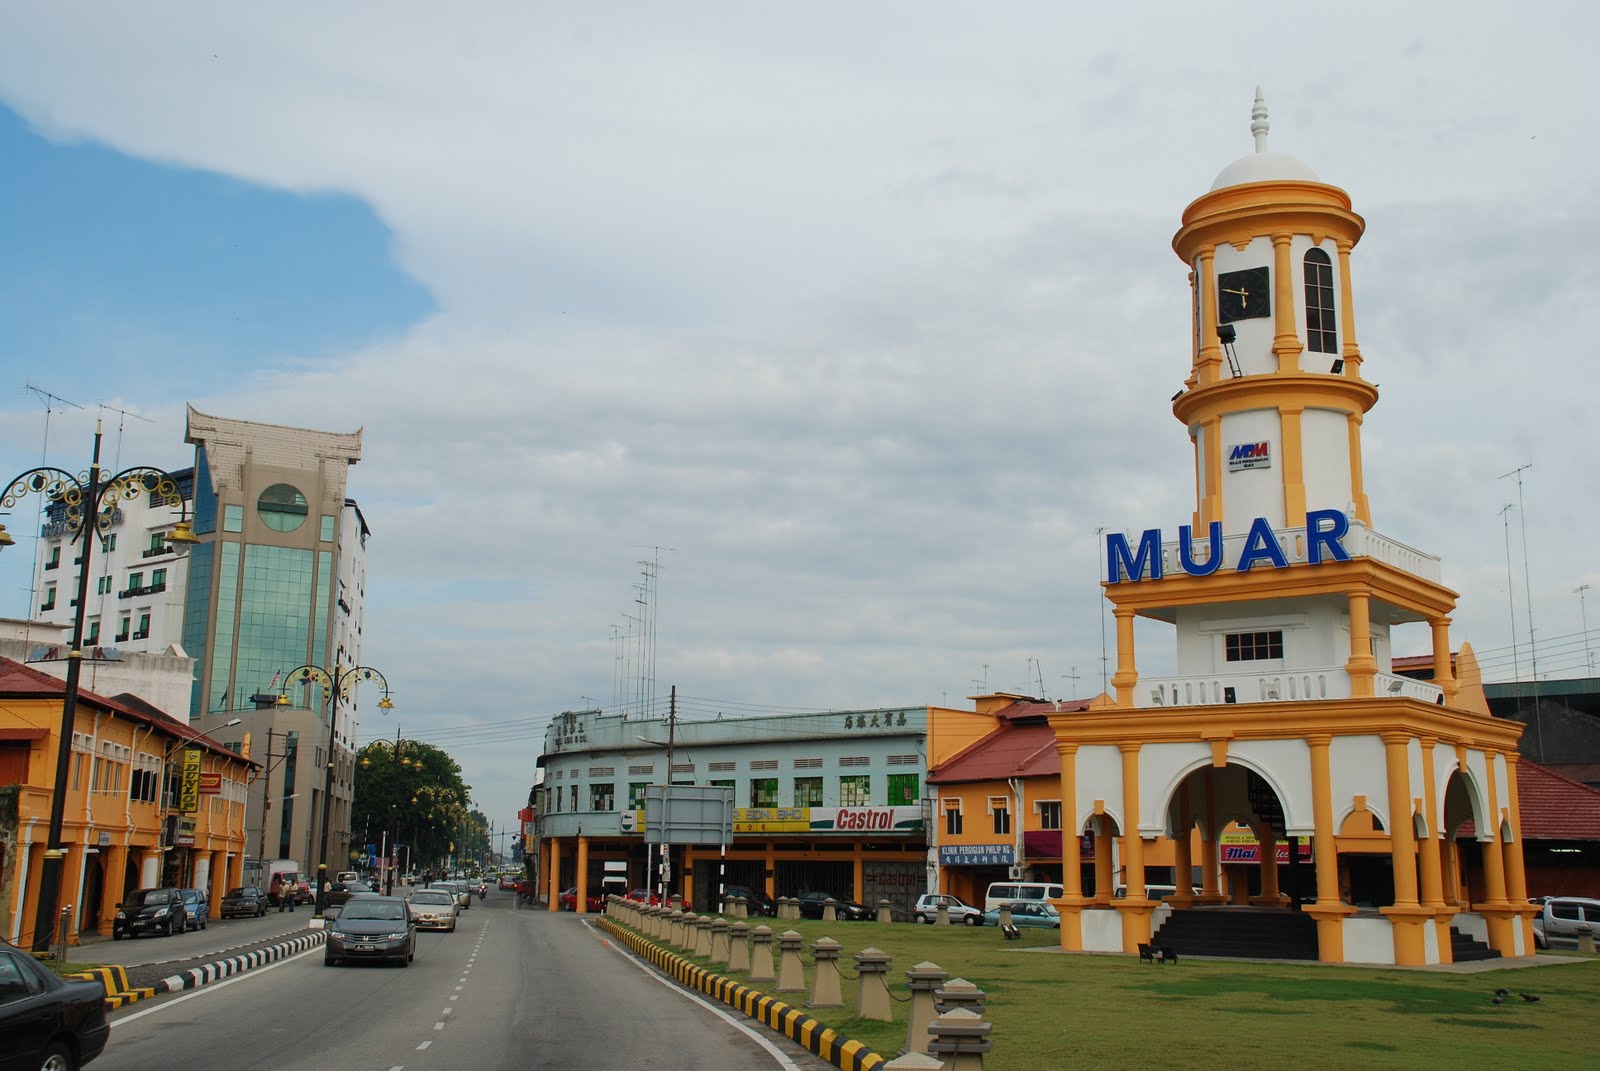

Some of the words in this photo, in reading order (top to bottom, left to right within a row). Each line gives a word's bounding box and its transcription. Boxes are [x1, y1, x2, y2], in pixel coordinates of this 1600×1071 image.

[1229, 442, 1267, 460] MPM
[1106, 508, 1351, 584] MUAR
[182, 763, 199, 810] DUNLOP
[745, 808, 774, 821] SDN.
[776, 808, 806, 821] BHD.
[836, 808, 895, 830] Castrol
[941, 846, 958, 855] KLINIK
[960, 846, 985, 855] PERGIGIAN
[985, 845, 1001, 854] PHILIP
[1002, 845, 1010, 854] NG
